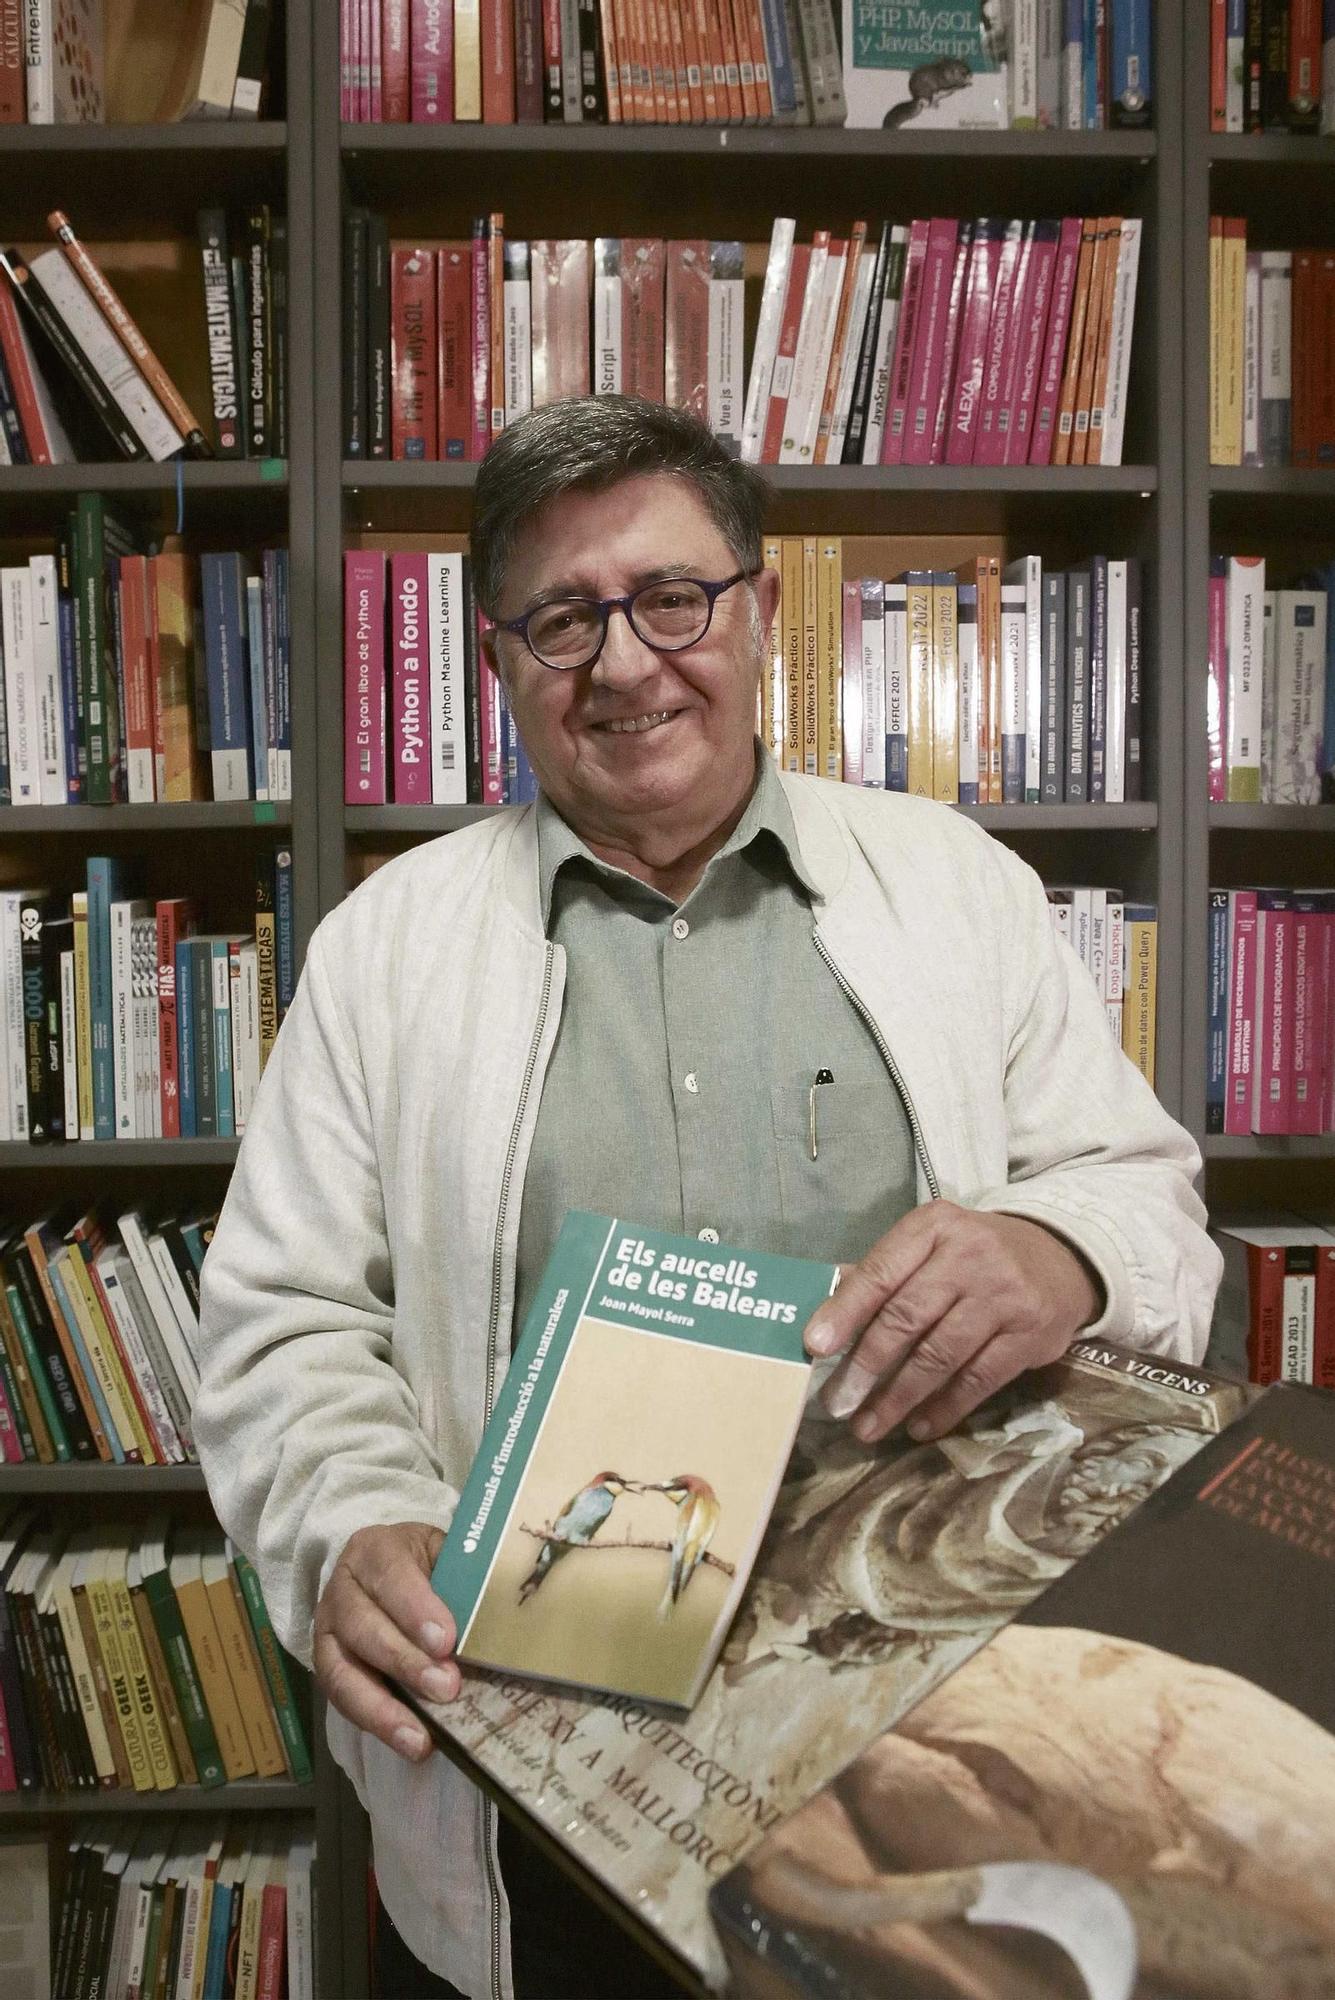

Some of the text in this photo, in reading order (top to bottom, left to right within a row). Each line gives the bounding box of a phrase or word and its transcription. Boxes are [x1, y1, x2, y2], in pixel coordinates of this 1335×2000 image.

[860, 33, 979, 60] y JavaScript
[253, 317, 265, 348] para
[717, 388, 732, 427] Vue.js
[870, 367, 890, 426] JavaScript
[956, 378, 976, 433] ALEXA
[827, 610, 835, 651] Simulation
[912, 594, 928, 628] 2022
[941, 595, 952, 656] Excel 2022
[1009, 621, 1019, 647] 2021
[356, 589, 372, 744] El gran libro de Python
[399, 577, 424, 764] Python a fondo
[437, 566, 454, 731] Python Machine Learning
[787, 633, 801, 682] Práctico
[864, 645, 872, 666] PHP
[1130, 606, 1140, 703] Python Deep Learning
[805, 624, 817, 745] SolidWorks Práctico II
[828, 697, 834, 706] de
[890, 668, 900, 732] OFFICE 2021
[1242, 680, 1250, 693] MF
[1290, 631, 1304, 756] Seguridad informática
[788, 684, 801, 750] SolidWorks
[866, 721, 874, 753] Design
[1071, 702, 1084, 749] ANALYTICS
[828, 742, 835, 750] El
[1047, 762, 1055, 774] SEO
[1071, 751, 1082, 773] DATA
[279, 873, 290, 918] MATES
[1093, 917, 1104, 940] Java
[1111, 924, 1123, 966] Hacking
[1139, 930, 1152, 959] Query
[23, 966, 43, 1018] 1000
[1139, 960, 1149, 990] Power
[1272, 922, 1284, 1071] PRINCIPIOS DE PROGRAMACIÓN
[1295, 924, 1306, 1071] CIRCUITOS LÓGICOS DIGITALES
[1137, 1010, 1148, 1032] datos
[1139, 992, 1148, 1008] con
[1233, 936, 1246, 1073] DESARROLLO DE MICROSERVICIOS
[49, 1039, 59, 1071] ChatGPT
[1138, 1034, 1148, 1045] de
[120, 1045, 128, 1101] MENTALIDADES
[615, 1238, 758, 1289] Els aucells
[599, 1295, 696, 1328] Joan Mayol Serra
[607, 1262, 799, 1324] de les Balears
[1071, 1345, 1211, 1396] UAN VICENS
[1287, 1316, 1299, 1383] utoCAD 2013
[466, 1288, 570, 1541] Manuals d'introducció a la naturalesa
[113, 1675, 145, 1772] CULTURA GEEK
[136, 1674, 168, 1771] CULTURA GEEK
[579, 1748, 740, 1878] A MALLORC
[243, 1950, 254, 1978] NFT
